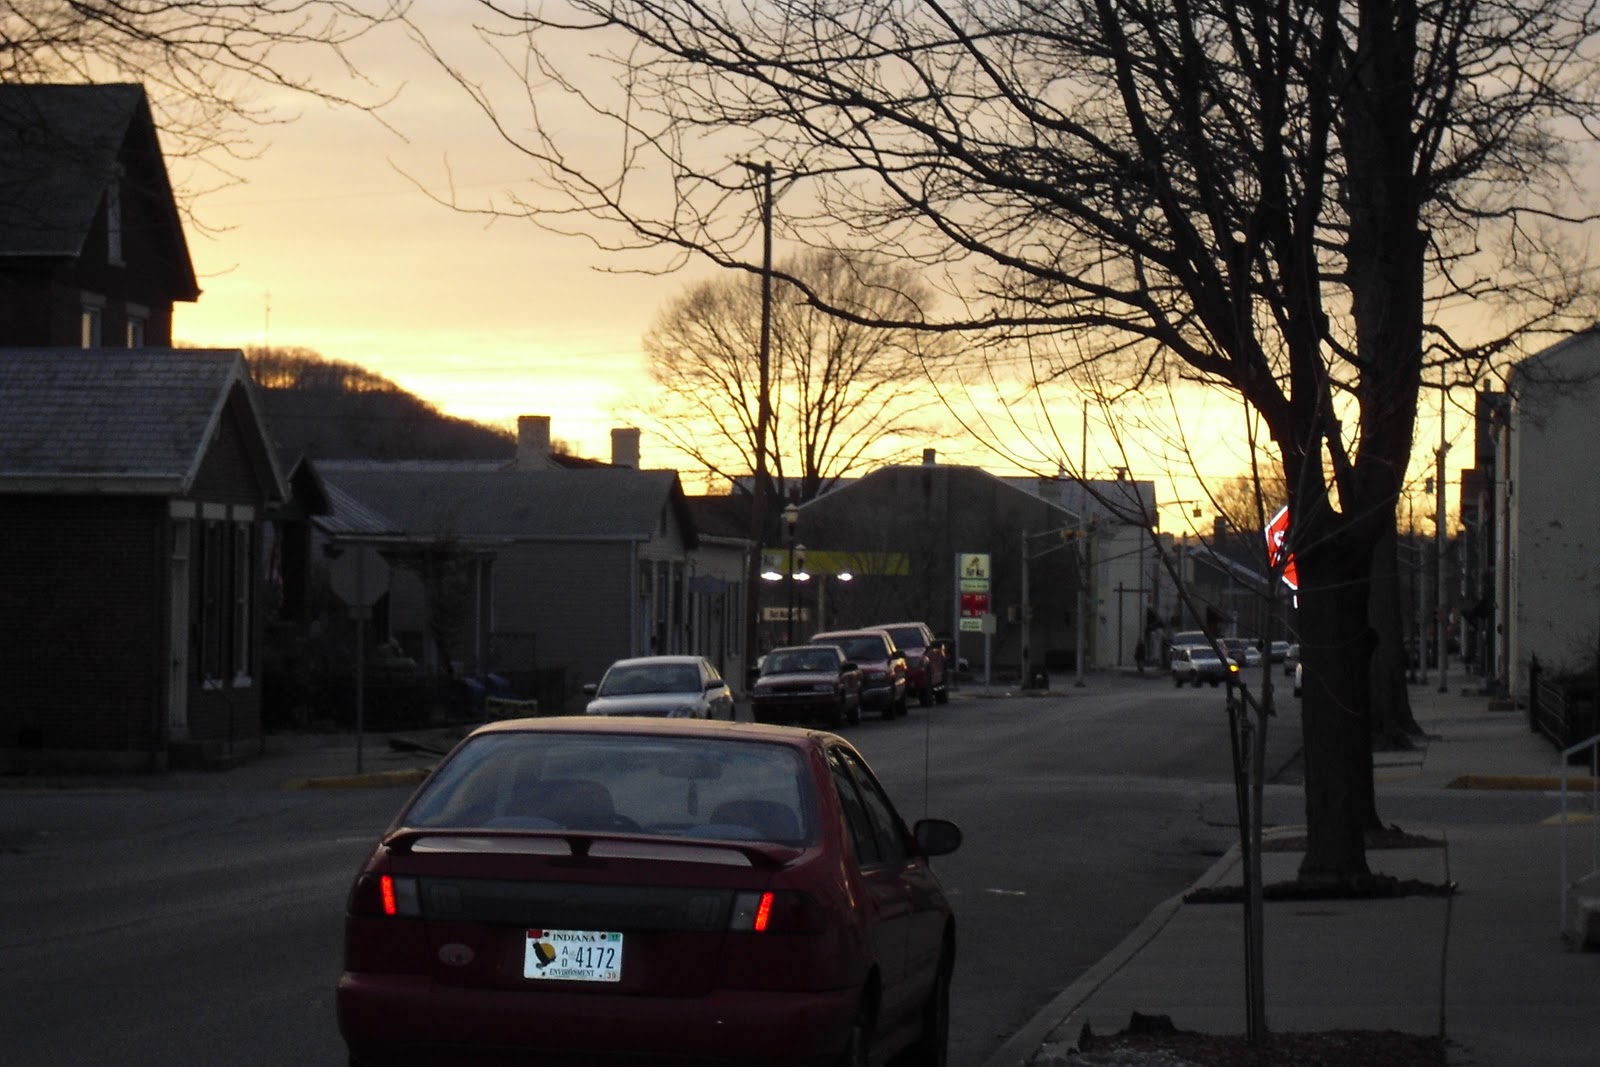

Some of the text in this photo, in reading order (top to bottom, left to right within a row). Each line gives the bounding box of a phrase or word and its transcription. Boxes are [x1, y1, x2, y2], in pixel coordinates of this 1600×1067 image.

[552, 933, 596, 942] INDIANA
[575, 946, 615, 969] 4172
[549, 968, 595, 977] ENVIRONMENT
